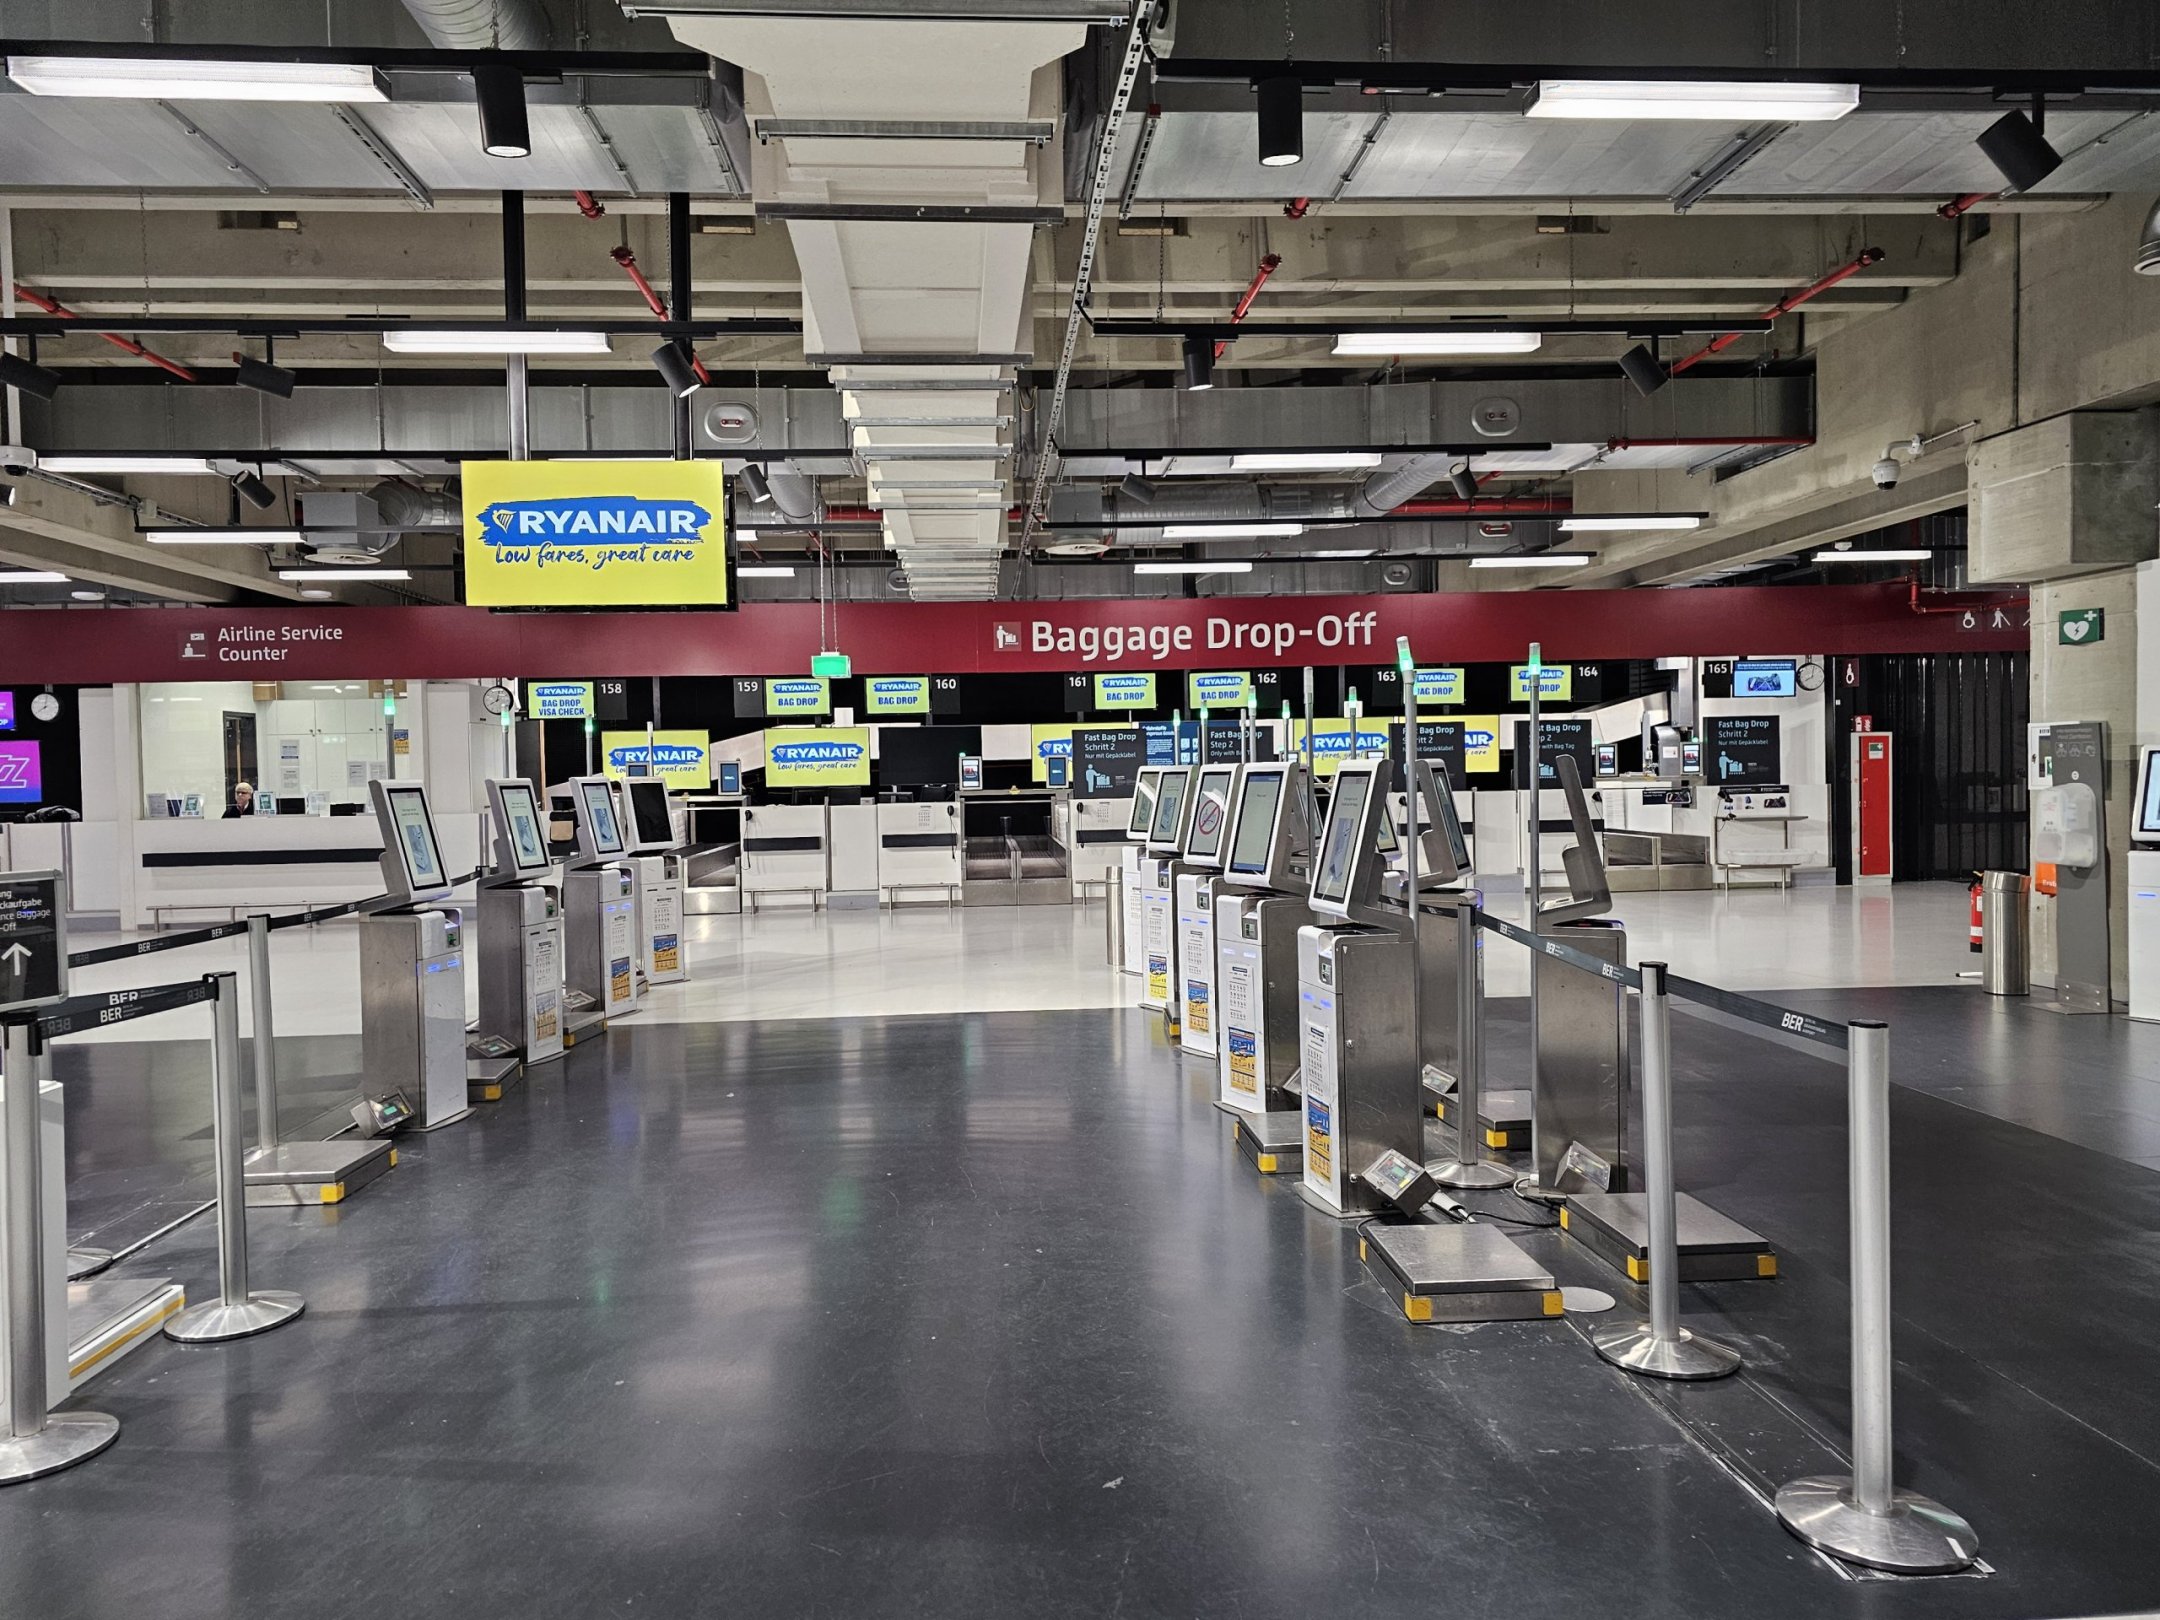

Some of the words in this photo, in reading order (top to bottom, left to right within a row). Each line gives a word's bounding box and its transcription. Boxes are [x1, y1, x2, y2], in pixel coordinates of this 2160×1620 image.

[518, 509, 698, 535] RYANAIR
[495, 543, 530, 564] Low
[537, 541, 590, 568] fares,
[592, 545, 648, 570] great
[652, 549, 695, 562] care
[218, 626, 276, 642] Airline
[281, 625, 343, 641] Service
[1031, 621, 1193, 661] Baggage
[1207, 611, 1377, 657] Drop-Off
[218, 646, 288, 662] Counter
[1578, 667, 1599, 678] 164
[1708, 663, 1728, 674] 165
[1069, 676, 1087, 687] 161
[1257, 673, 1277, 684] 162
[1377, 671, 1397, 682] 163
[1418, 674, 1456, 682] RYANAIR
[601, 683, 622, 694] 158
[737, 681, 758, 692] 159
[781, 684, 820, 692] RYANAIR
[935, 679, 956, 690] 160
[1109, 679, 1146, 687] RYANAIR
[1539, 683, 1561, 692] DROP
[544, 687, 584, 695] RYANAIR
[1106, 693, 1122, 701] BAG
[1123, 692, 1145, 700] DROP
[1201, 691, 1217, 700] BAG
[1218, 691, 1239, 700] DROP
[1417, 687, 1431, 696] AG
[1432, 687, 1454, 695] DROP
[542, 699, 558, 707] BAG
[560, 699, 581, 707] DROP
[778, 698, 794, 706] BAG
[796, 697, 818, 706] DROP
[878, 697, 895, 705] BAG
[896, 696, 918, 705] DROP
[538, 708, 557, 716] VISA
[559, 708, 585, 716] CHECK
[1546, 725, 1561, 734] Bag
[1562, 724, 1581, 733] Drop
[1735, 720, 1749, 729] Bag
[1750, 720, 1769, 729] Drop
[1210, 731, 1226, 741] Fast
[1227, 730, 1242, 742] Bag
[1420, 727, 1434, 736] Bag
[1435, 727, 1454, 736] Drop
[1718, 730, 1742, 738] Schritt
[1084, 733, 1101, 742] Fast
[1101, 733, 1117, 743] Bag
[1118, 732, 1137, 742] Drop
[1428, 736, 1433, 744] 2
[1110, 743, 1116, 751] 2
[1210, 740, 1227, 749] Step
[1228, 740, 1234, 748] 2
[625, 750, 698, 762] RYANAIR
[787, 747, 859, 758] RYANAIR
[1210, 750, 1223, 759] Only
[16, 909, 51, 920] Baggage
[211, 928, 223, 938] BER
[138, 942, 151, 953] BER
[1545, 942, 1556, 955] BER
[1602, 962, 1614, 978] BER
[100, 1006, 122, 1023] BER
[1781, 1012, 1804, 1032] BER
